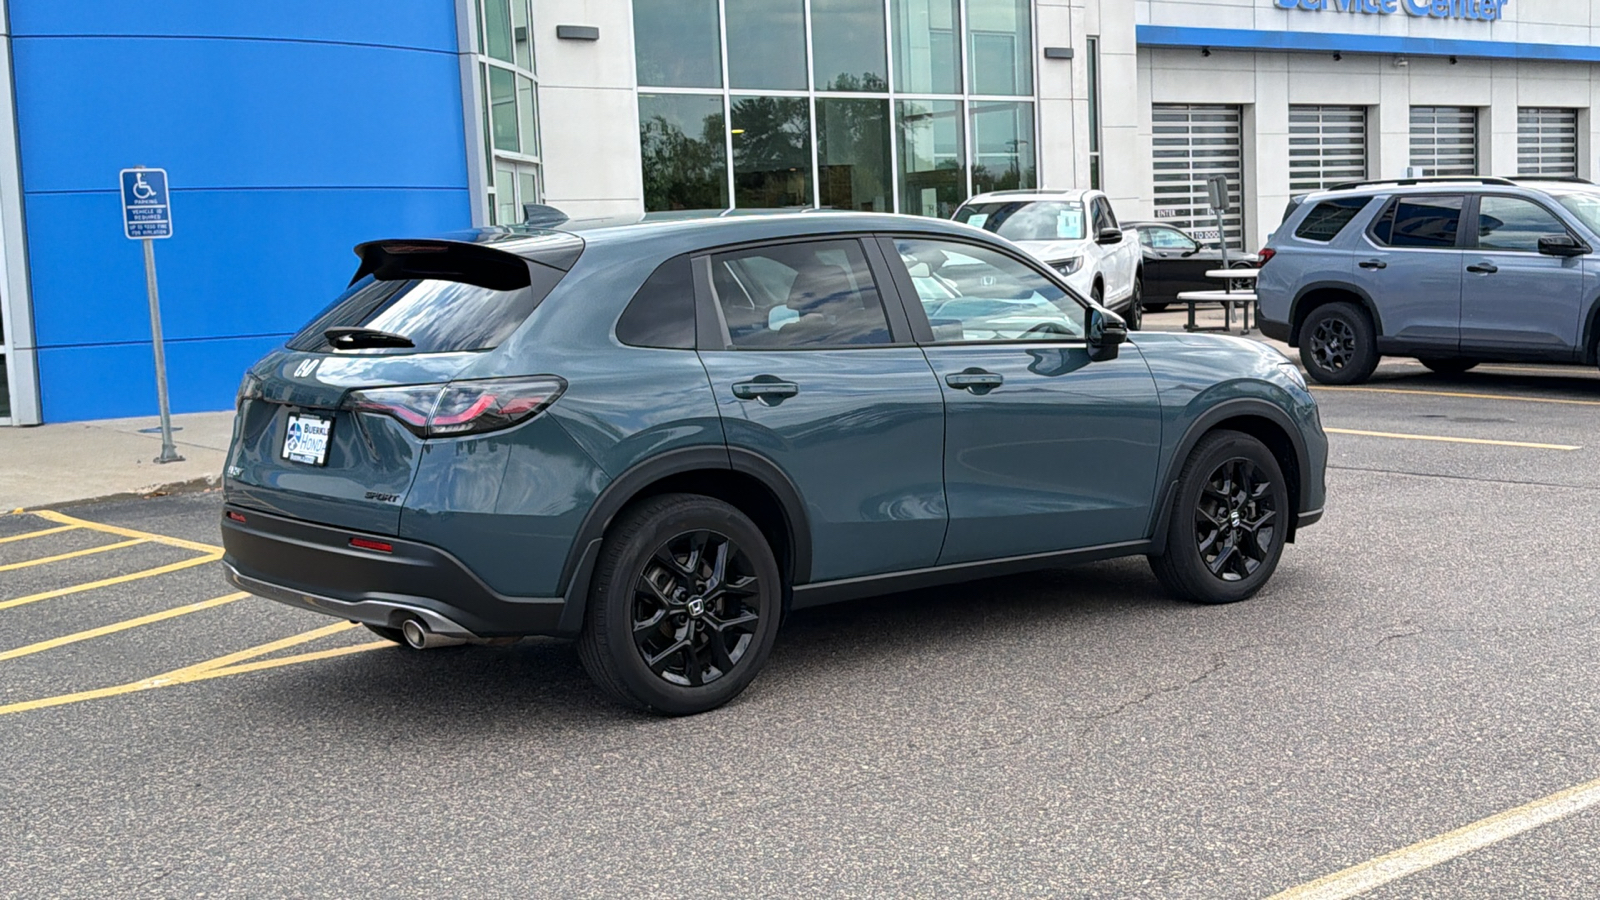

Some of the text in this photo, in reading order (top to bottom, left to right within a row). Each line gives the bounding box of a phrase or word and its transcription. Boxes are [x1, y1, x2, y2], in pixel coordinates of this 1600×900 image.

[1157, 209, 1176, 218] ENTER
[1204, 231, 1220, 239] DOO
[304, 423, 330, 436] BUERKL
[365, 491, 400, 503] SPORT
